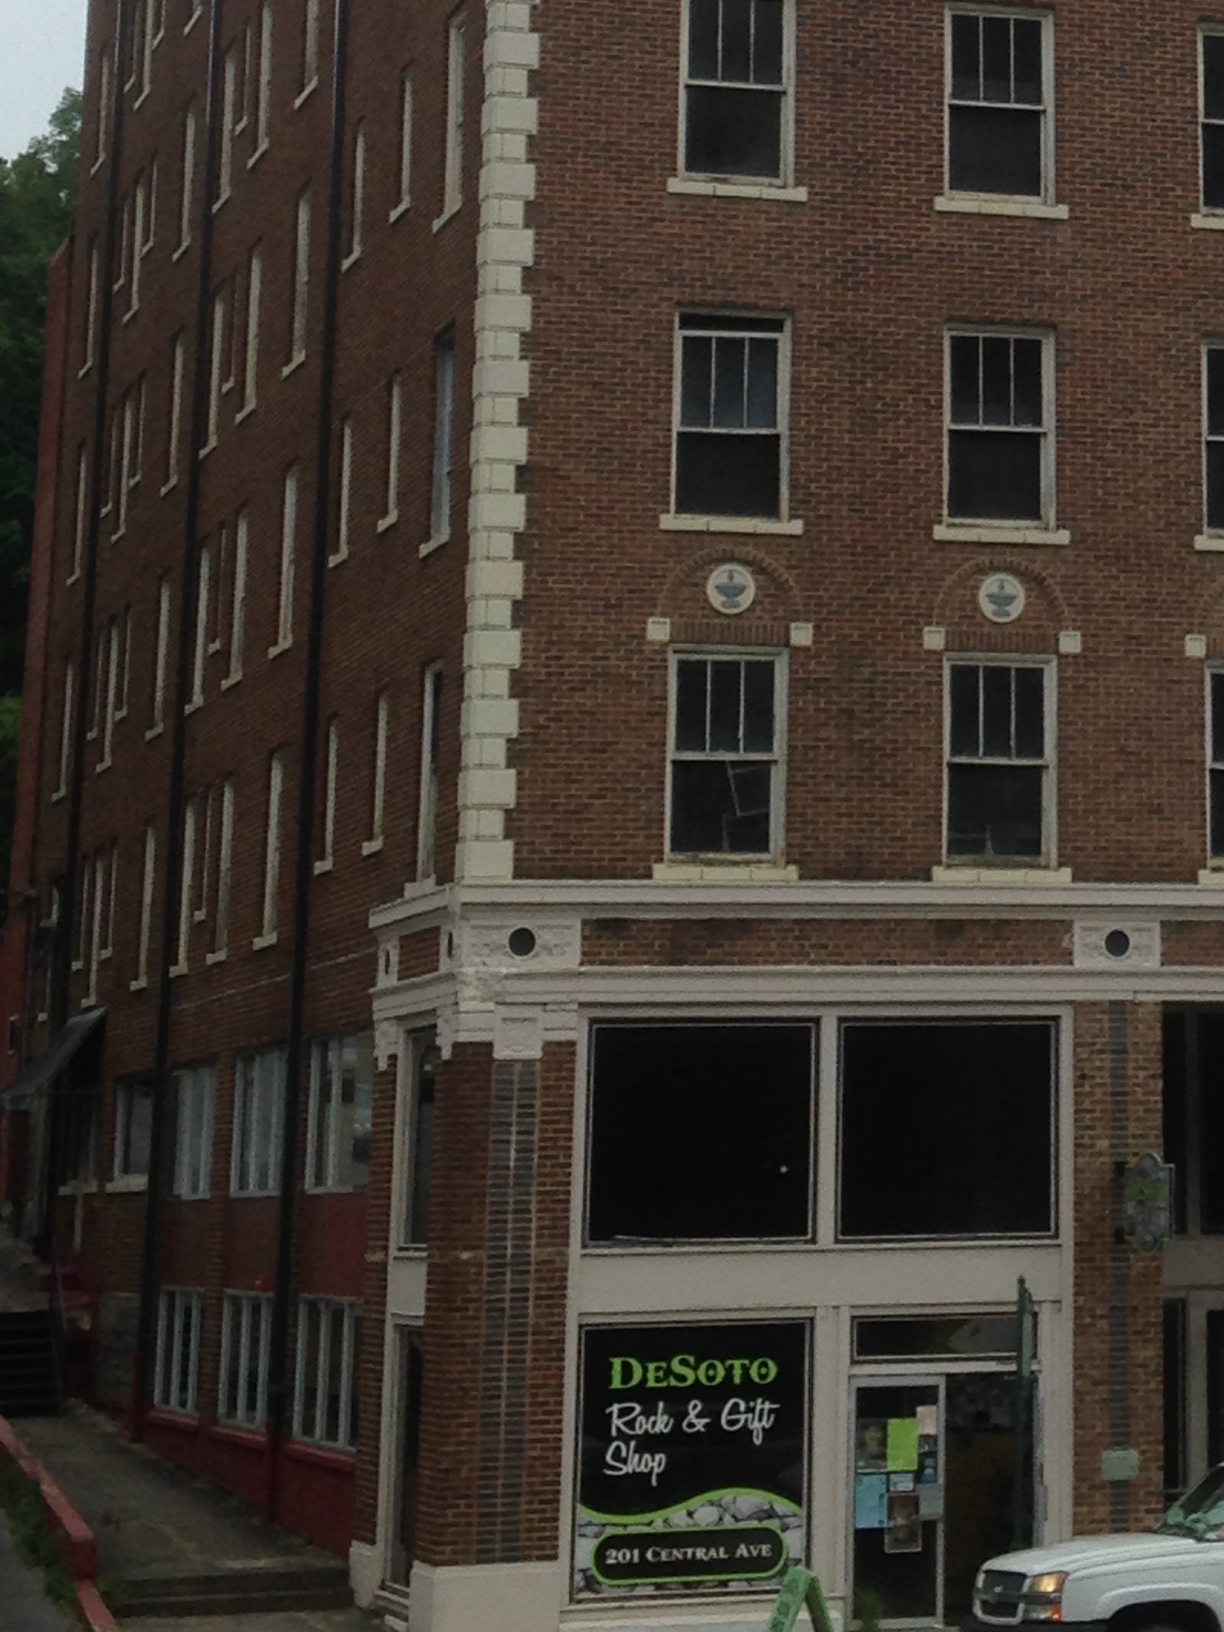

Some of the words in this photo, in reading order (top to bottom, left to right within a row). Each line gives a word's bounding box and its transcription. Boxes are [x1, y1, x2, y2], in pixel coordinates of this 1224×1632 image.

[605, 1401, 674, 1437] Rock
[682, 1399, 711, 1433] &
[720, 1397, 781, 1445] Gift
[603, 1440, 666, 1487] Shop
[604, 1548, 640, 1565] 201
